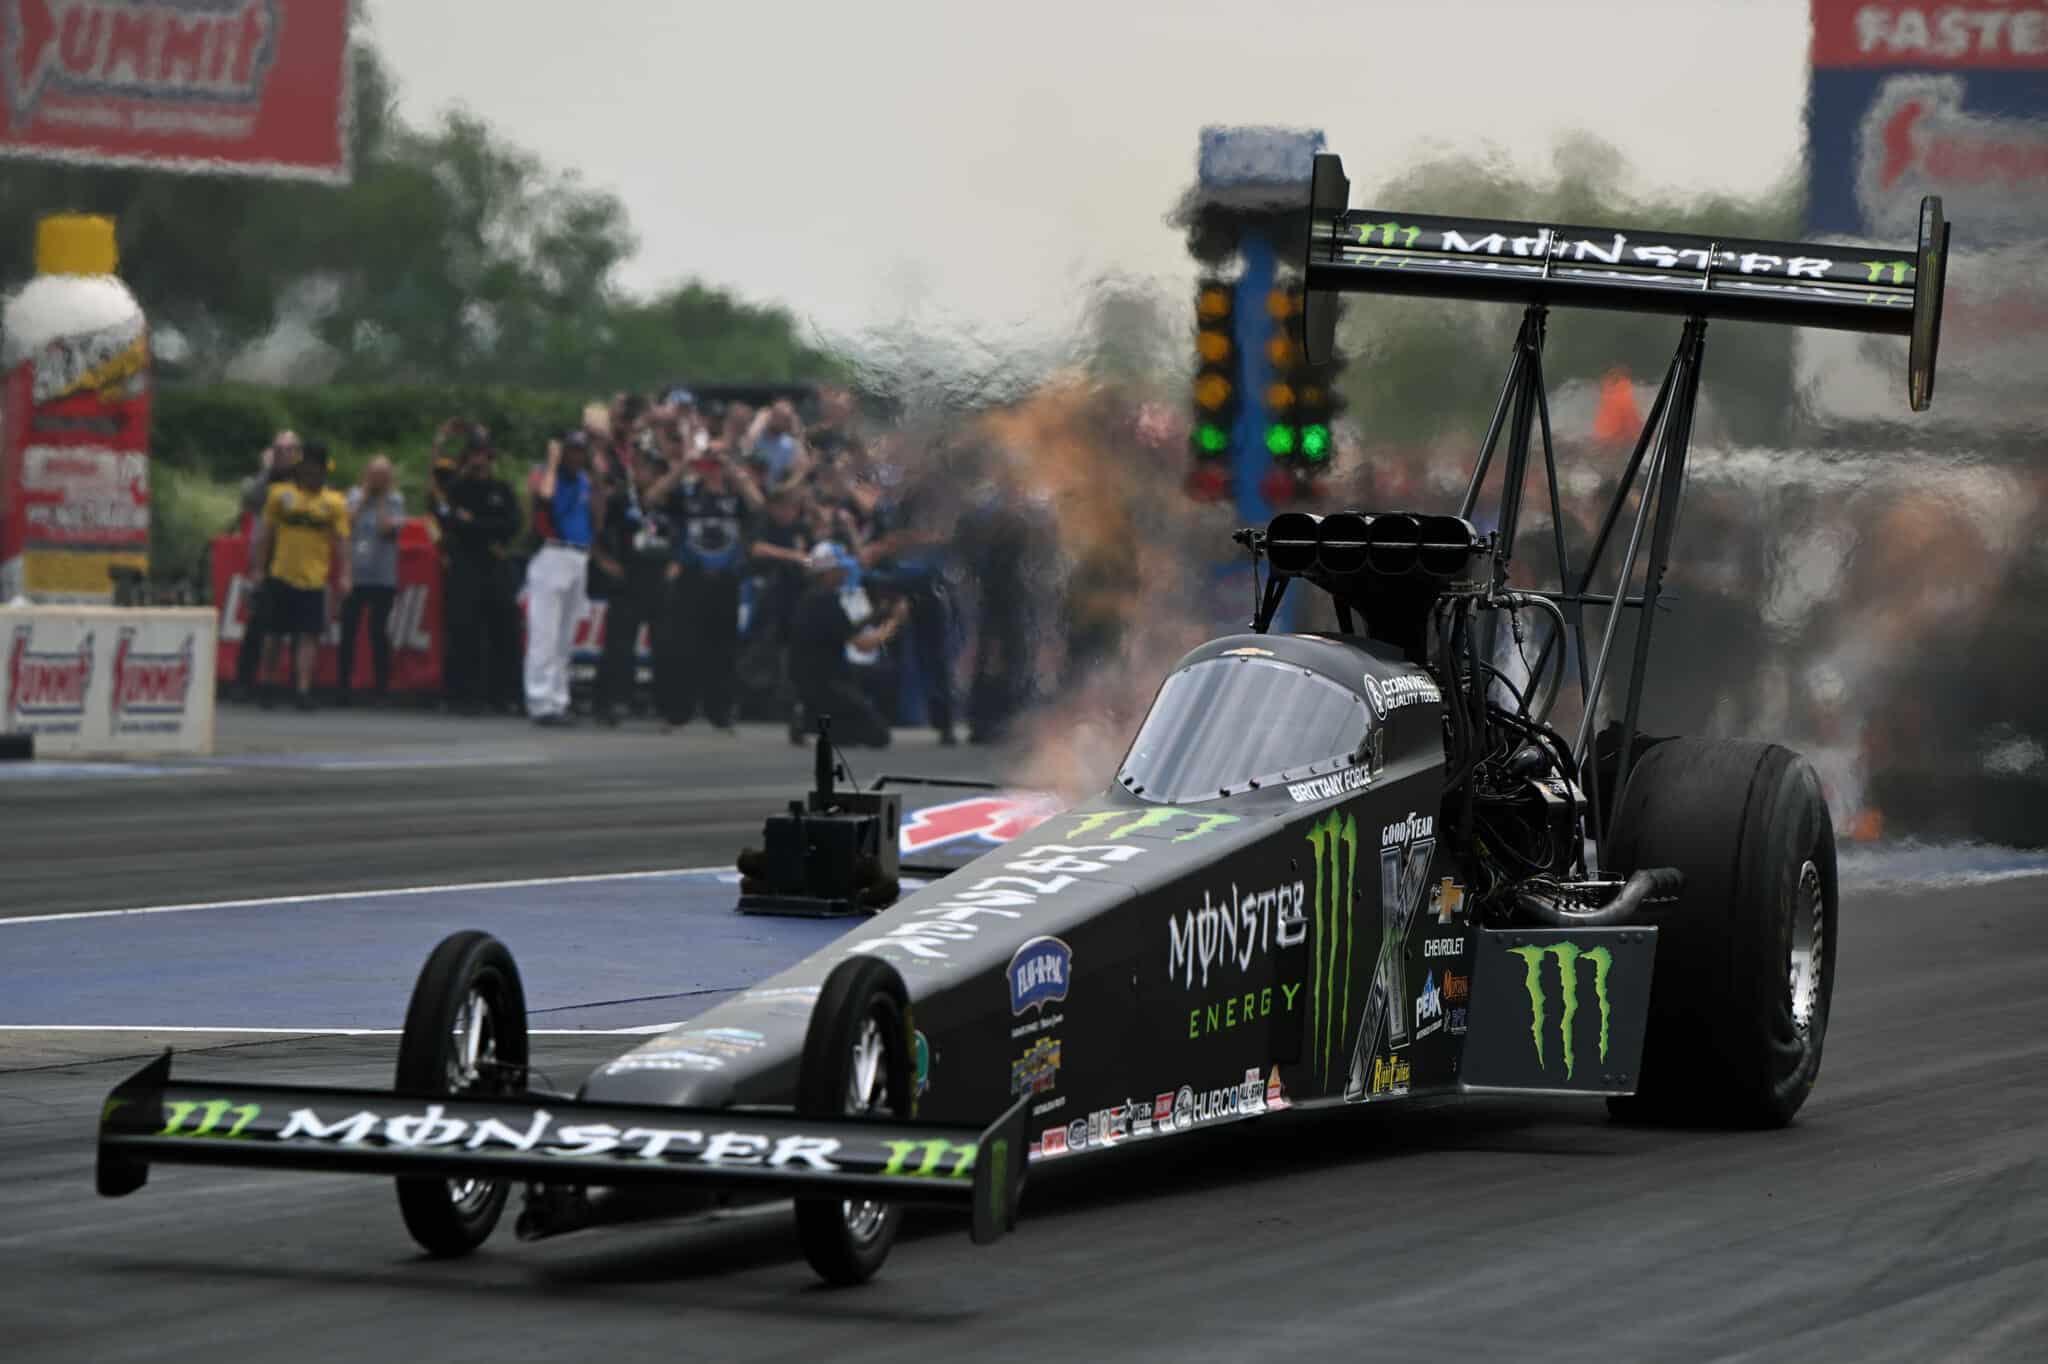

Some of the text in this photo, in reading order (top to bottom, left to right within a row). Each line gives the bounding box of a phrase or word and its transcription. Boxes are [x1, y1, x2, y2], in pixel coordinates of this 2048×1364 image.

[1381, 673, 1437, 695] CORNWELL
[1386, 692, 1418, 710] QUALITY
[1287, 764, 1372, 803] BRITTANY FORCE
[1168, 878, 1308, 990] MONSTER
[1424, 938, 1464, 957] CHEVROLET
[1189, 983, 1301, 1039] ENERGY
[1416, 986, 1442, 1029] PEAK
[1193, 1086, 1239, 1122] HURCO
[278, 1105, 842, 1171] MONSTER
